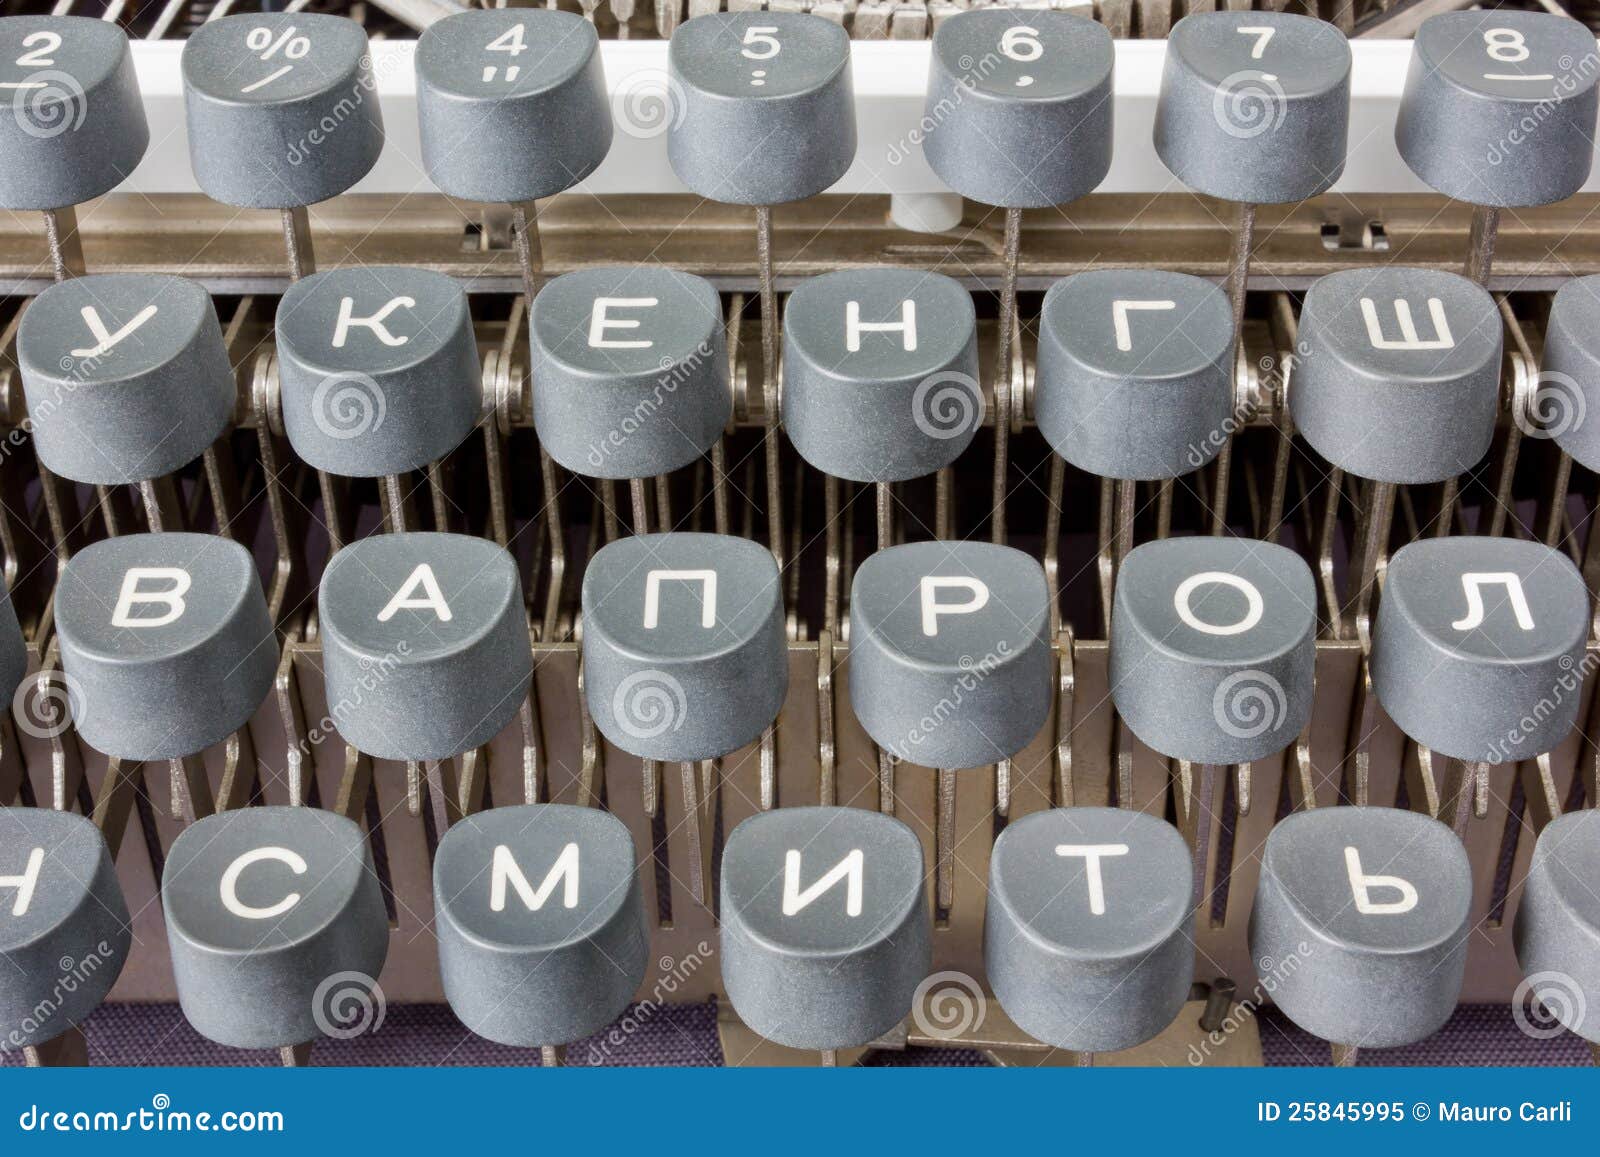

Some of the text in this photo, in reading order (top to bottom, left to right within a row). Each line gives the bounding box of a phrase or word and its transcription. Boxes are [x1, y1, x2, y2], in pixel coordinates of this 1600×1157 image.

[15, 31, 63, 66] 2
[245, 26, 311, 60] %
[485, 23, 528, 56] 4
[740, 26, 781, 60] 5
[1001, 26, 1044, 62] 6
[1236, 26, 1276, 59] 7
[1483, 28, 1530, 62] 8
[70, 304, 159, 358] У
[331, 295, 416, 348] К
[587, 297, 659, 348] Е
[846, 299, 917, 352] Н
[1112, 300, 1176, 352] Г
[1359, 297, 1456, 350] Ш
[111, 567, 192, 628] В
[377, 563, 453, 622] А
[643, 569, 718, 630] П
[919, 575, 990, 636] Р
[1173, 571, 1264, 636] О
[1451, 571, 1536, 631] Л
[782, 848, 864, 917] И
